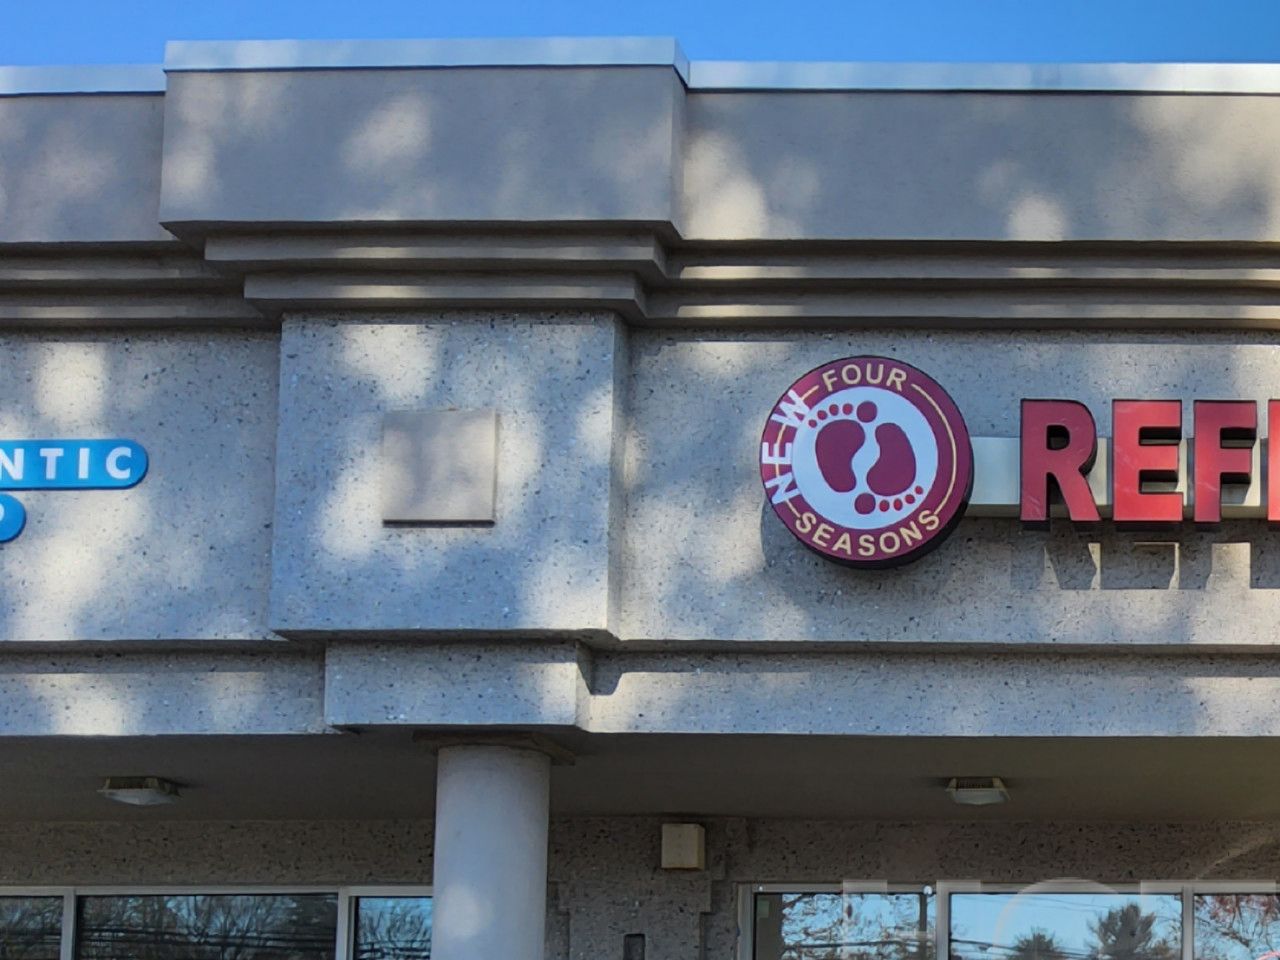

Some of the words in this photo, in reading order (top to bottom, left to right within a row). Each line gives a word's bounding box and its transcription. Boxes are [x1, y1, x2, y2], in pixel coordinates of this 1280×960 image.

[761, 389, 811, 505] NEW
[821, 363, 908, 392] FOUR
[795, 509, 940, 556] SEASONS
